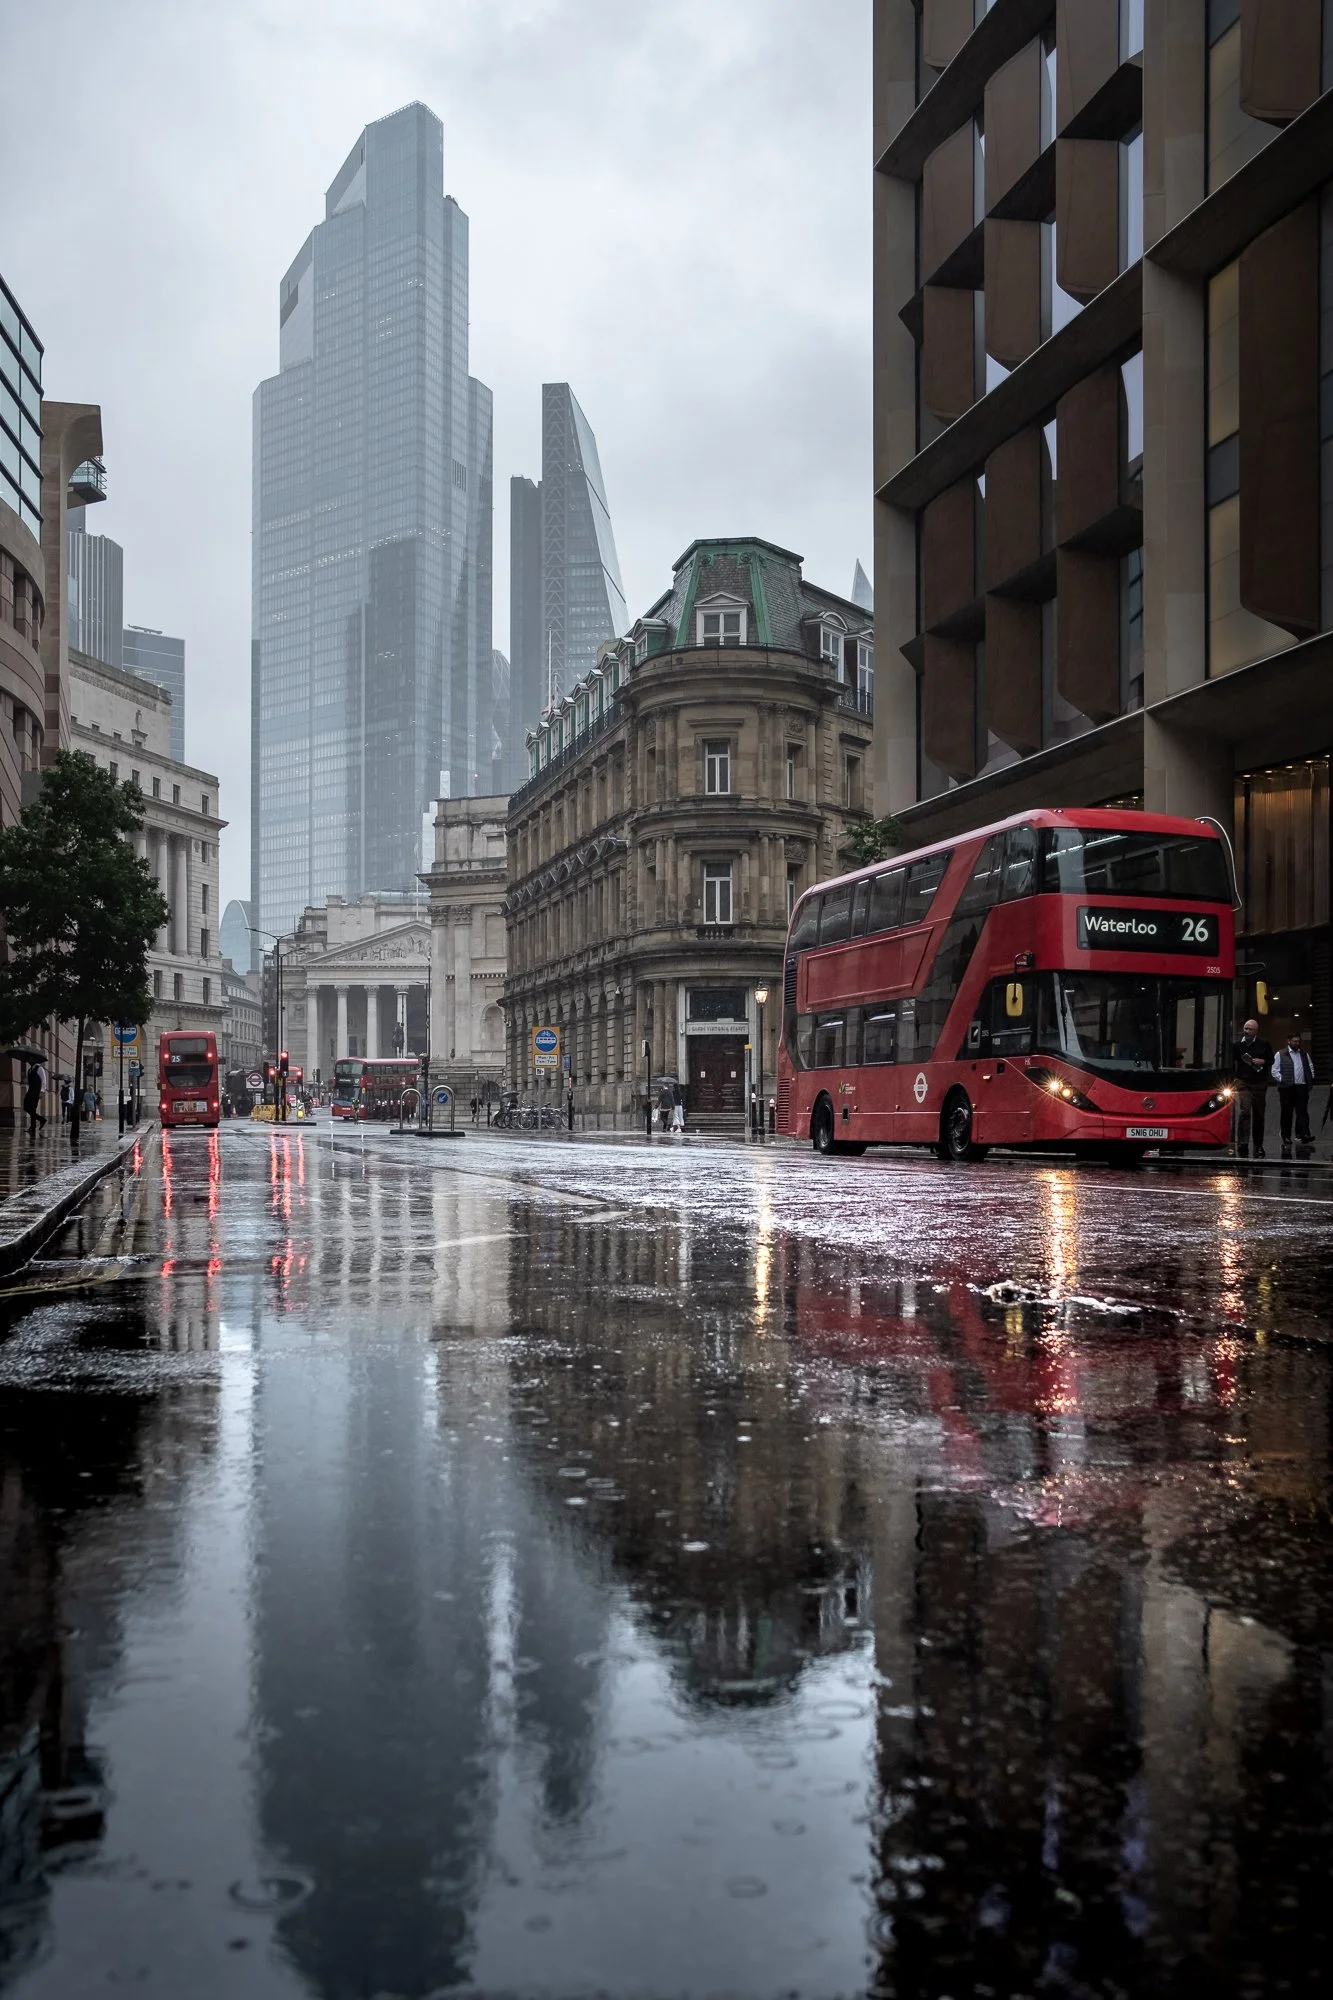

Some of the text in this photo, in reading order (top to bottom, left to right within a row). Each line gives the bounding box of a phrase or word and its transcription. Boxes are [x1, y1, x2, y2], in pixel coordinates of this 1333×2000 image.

[1084, 915, 1209, 942] Waterloo 26
[1207, 966, 1221, 974] 2505
[171, 1055, 181, 1063] 25
[1130, 1128, 1164, 1137] SN16 OHU
